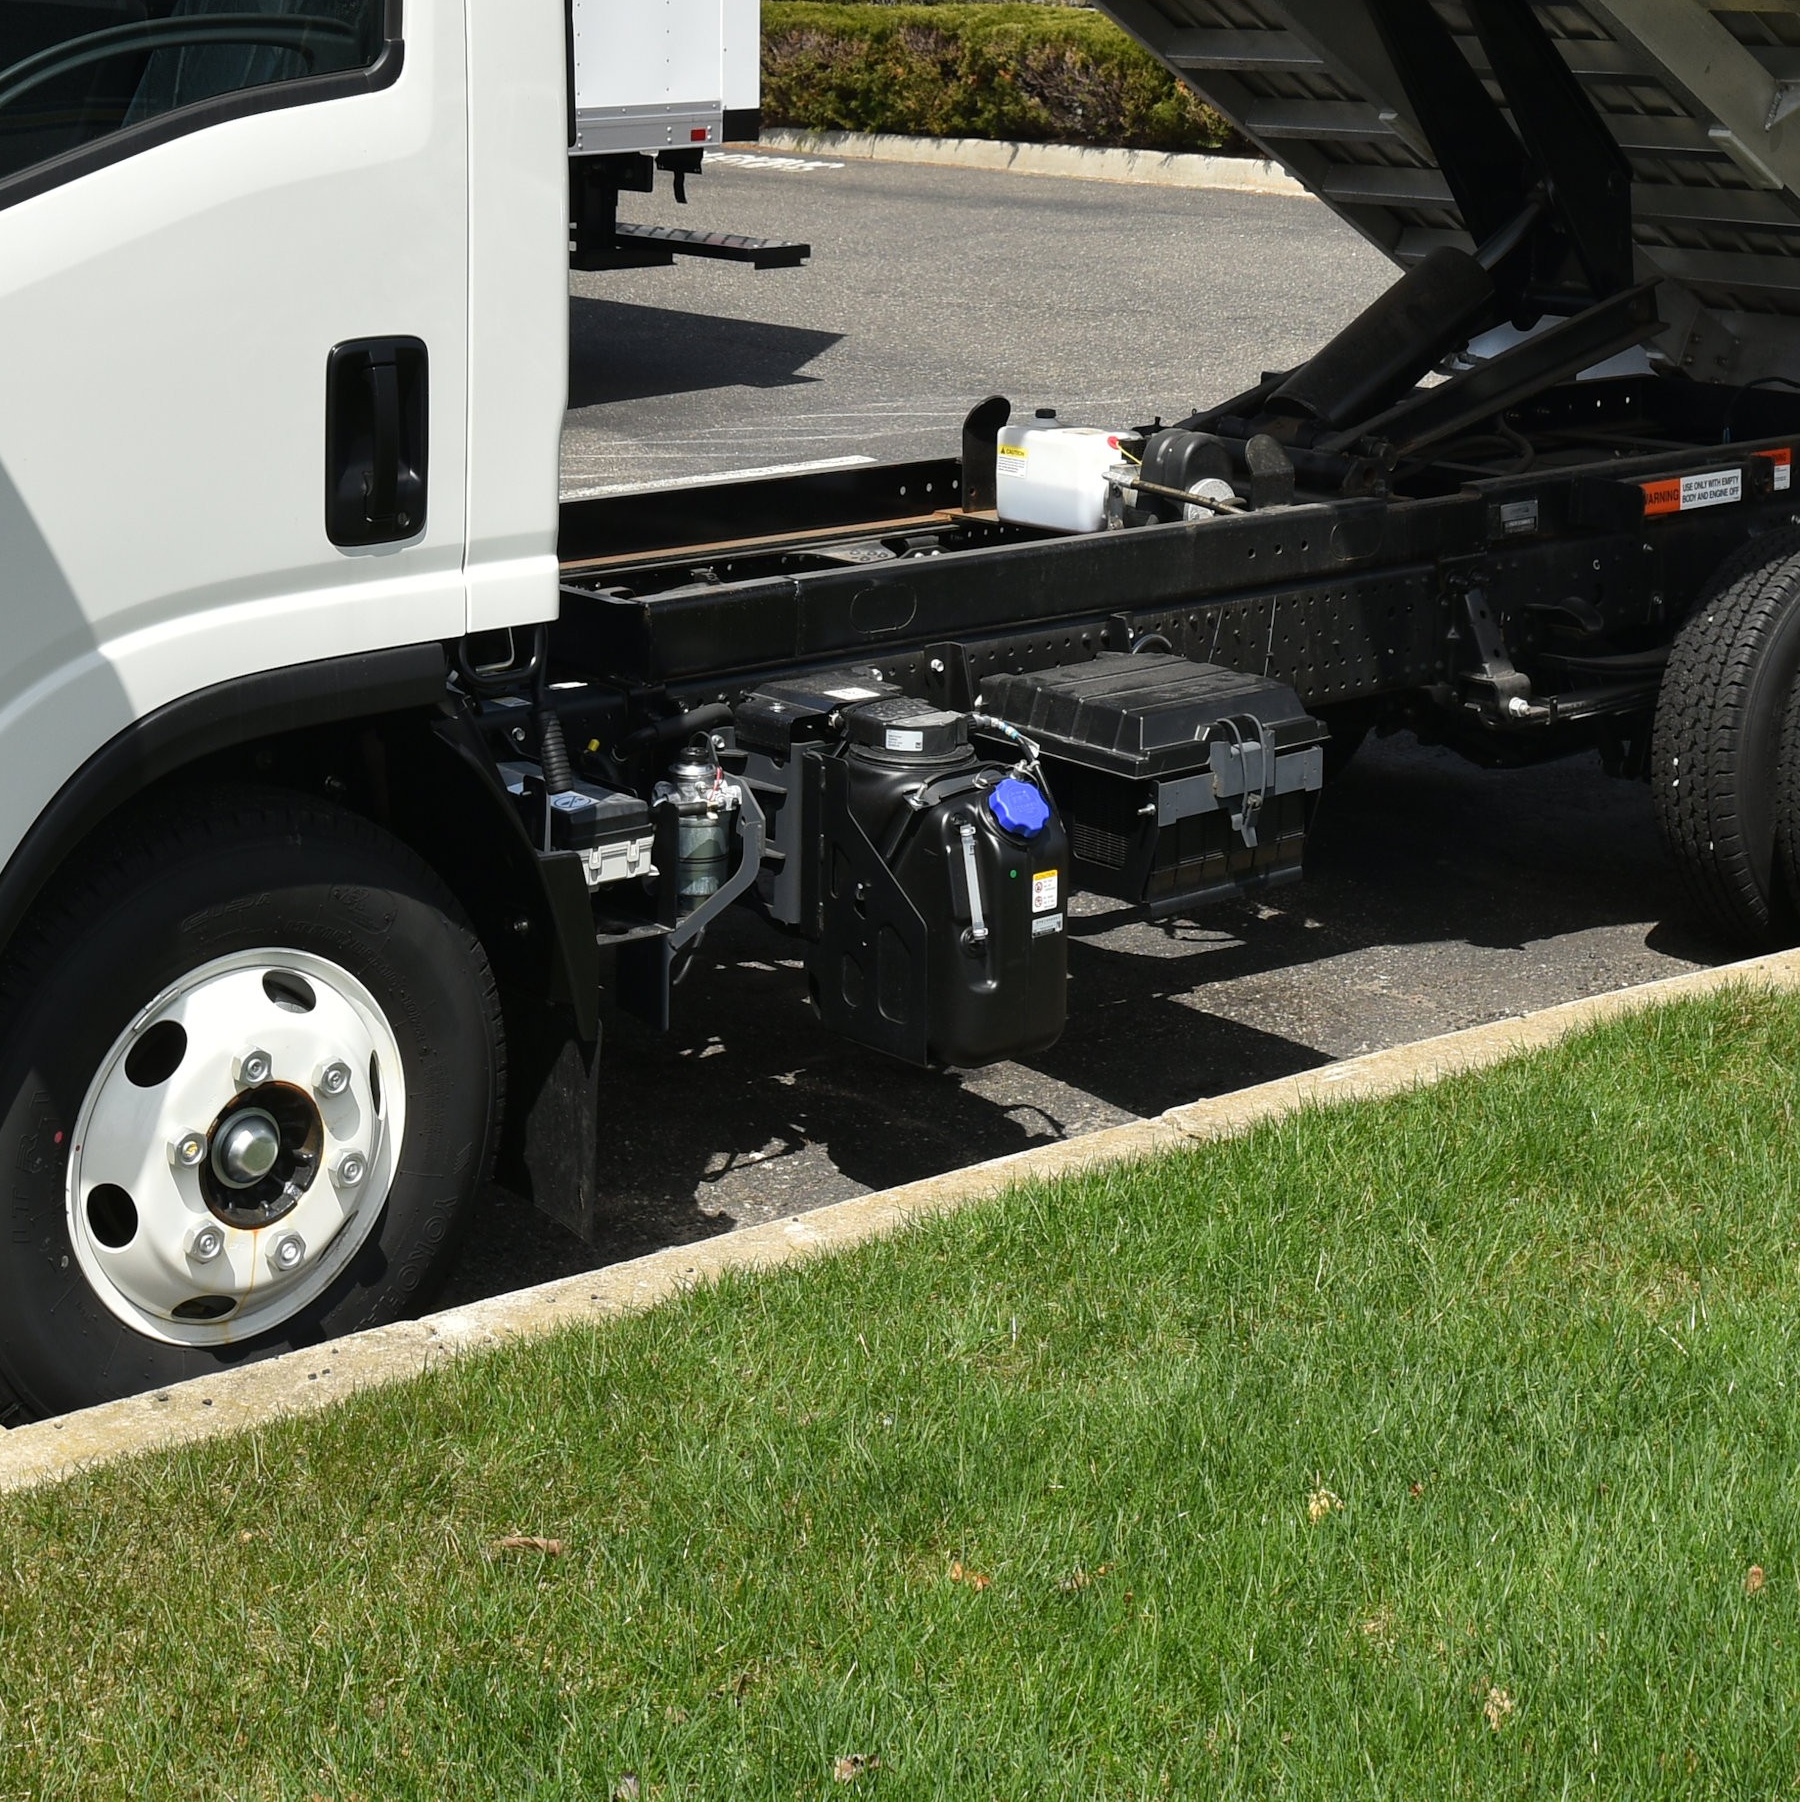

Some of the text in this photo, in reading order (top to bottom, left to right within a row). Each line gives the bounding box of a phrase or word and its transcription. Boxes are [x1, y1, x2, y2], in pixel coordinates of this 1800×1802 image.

[1682, 475, 1739, 492] USE ONLY WITH EMPTY
[1682, 492, 1696, 504] BODY
[1698, 490, 1708, 500] AND
[1709, 488, 1728, 499] ENGINE
[1729, 486, 1739, 496] OFF
